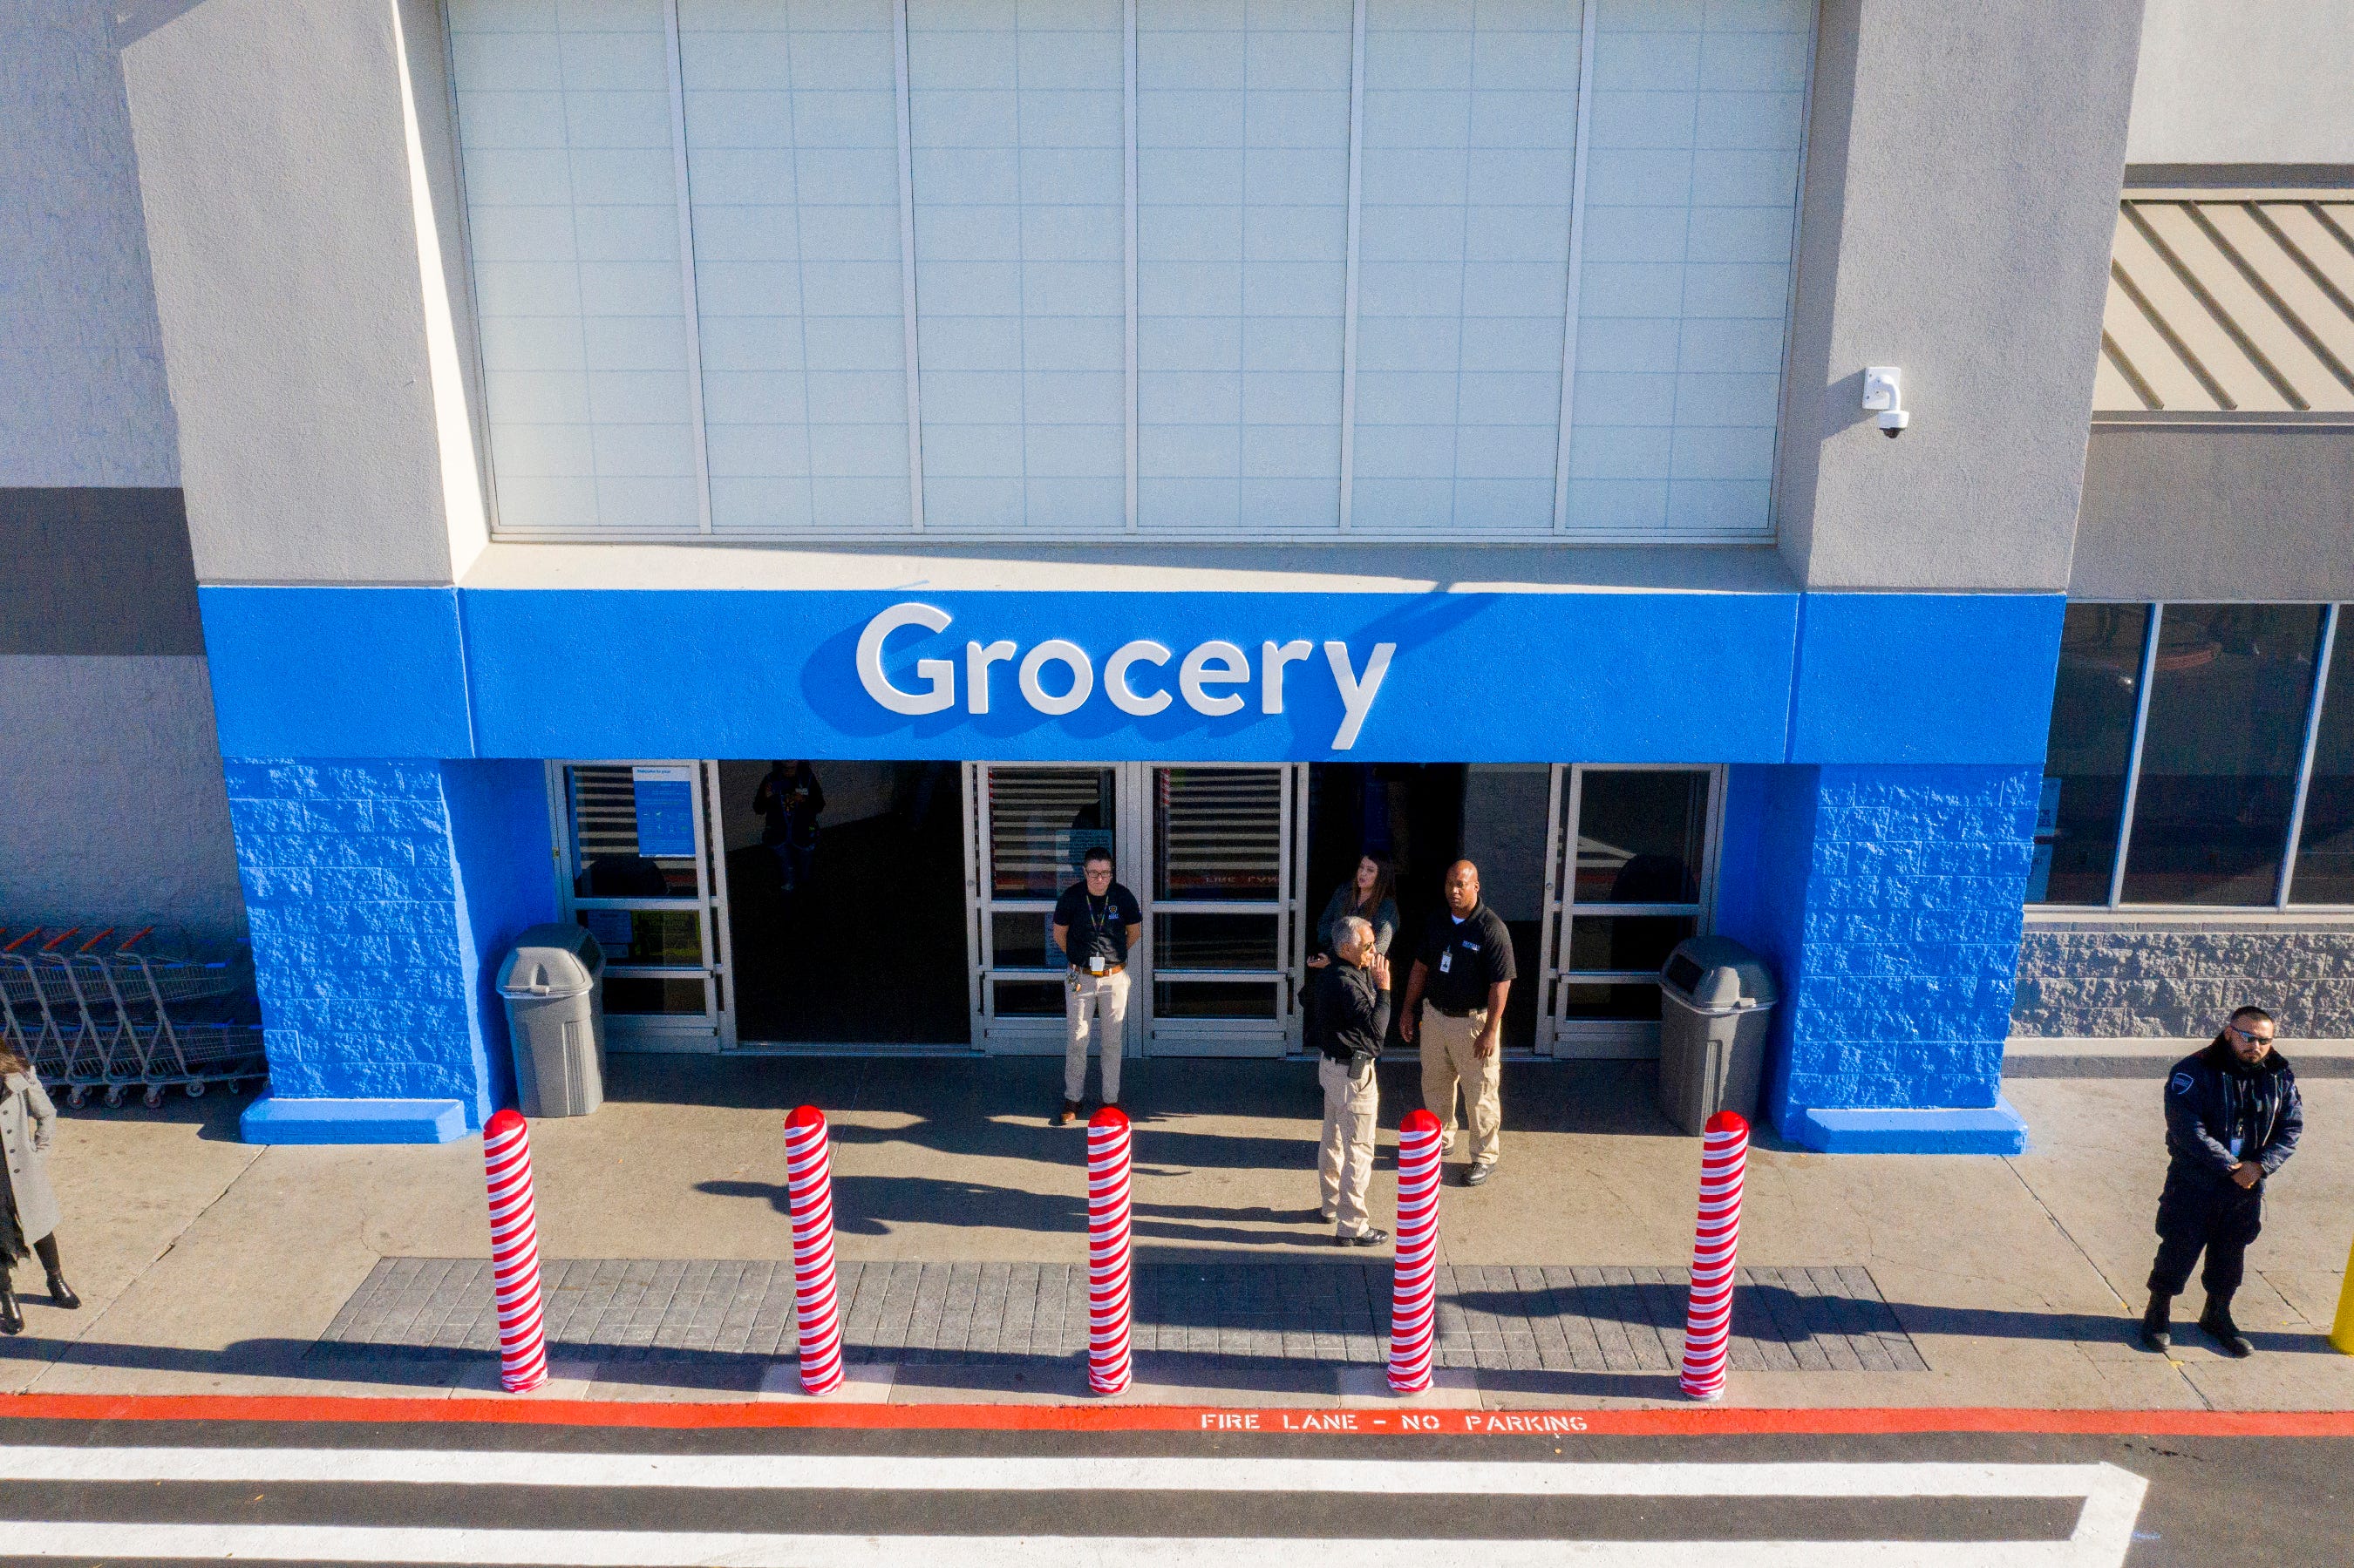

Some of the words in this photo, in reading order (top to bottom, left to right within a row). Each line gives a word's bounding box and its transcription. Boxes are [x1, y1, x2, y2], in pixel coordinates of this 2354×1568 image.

[856, 602, 1397, 750] Grocery
[1201, 1414, 1261, 1429] FIRE
[1282, 1414, 1358, 1430] LANE
[1401, 1415, 1440, 1430] NO
[1465, 1415, 1588, 1431] PARKING
